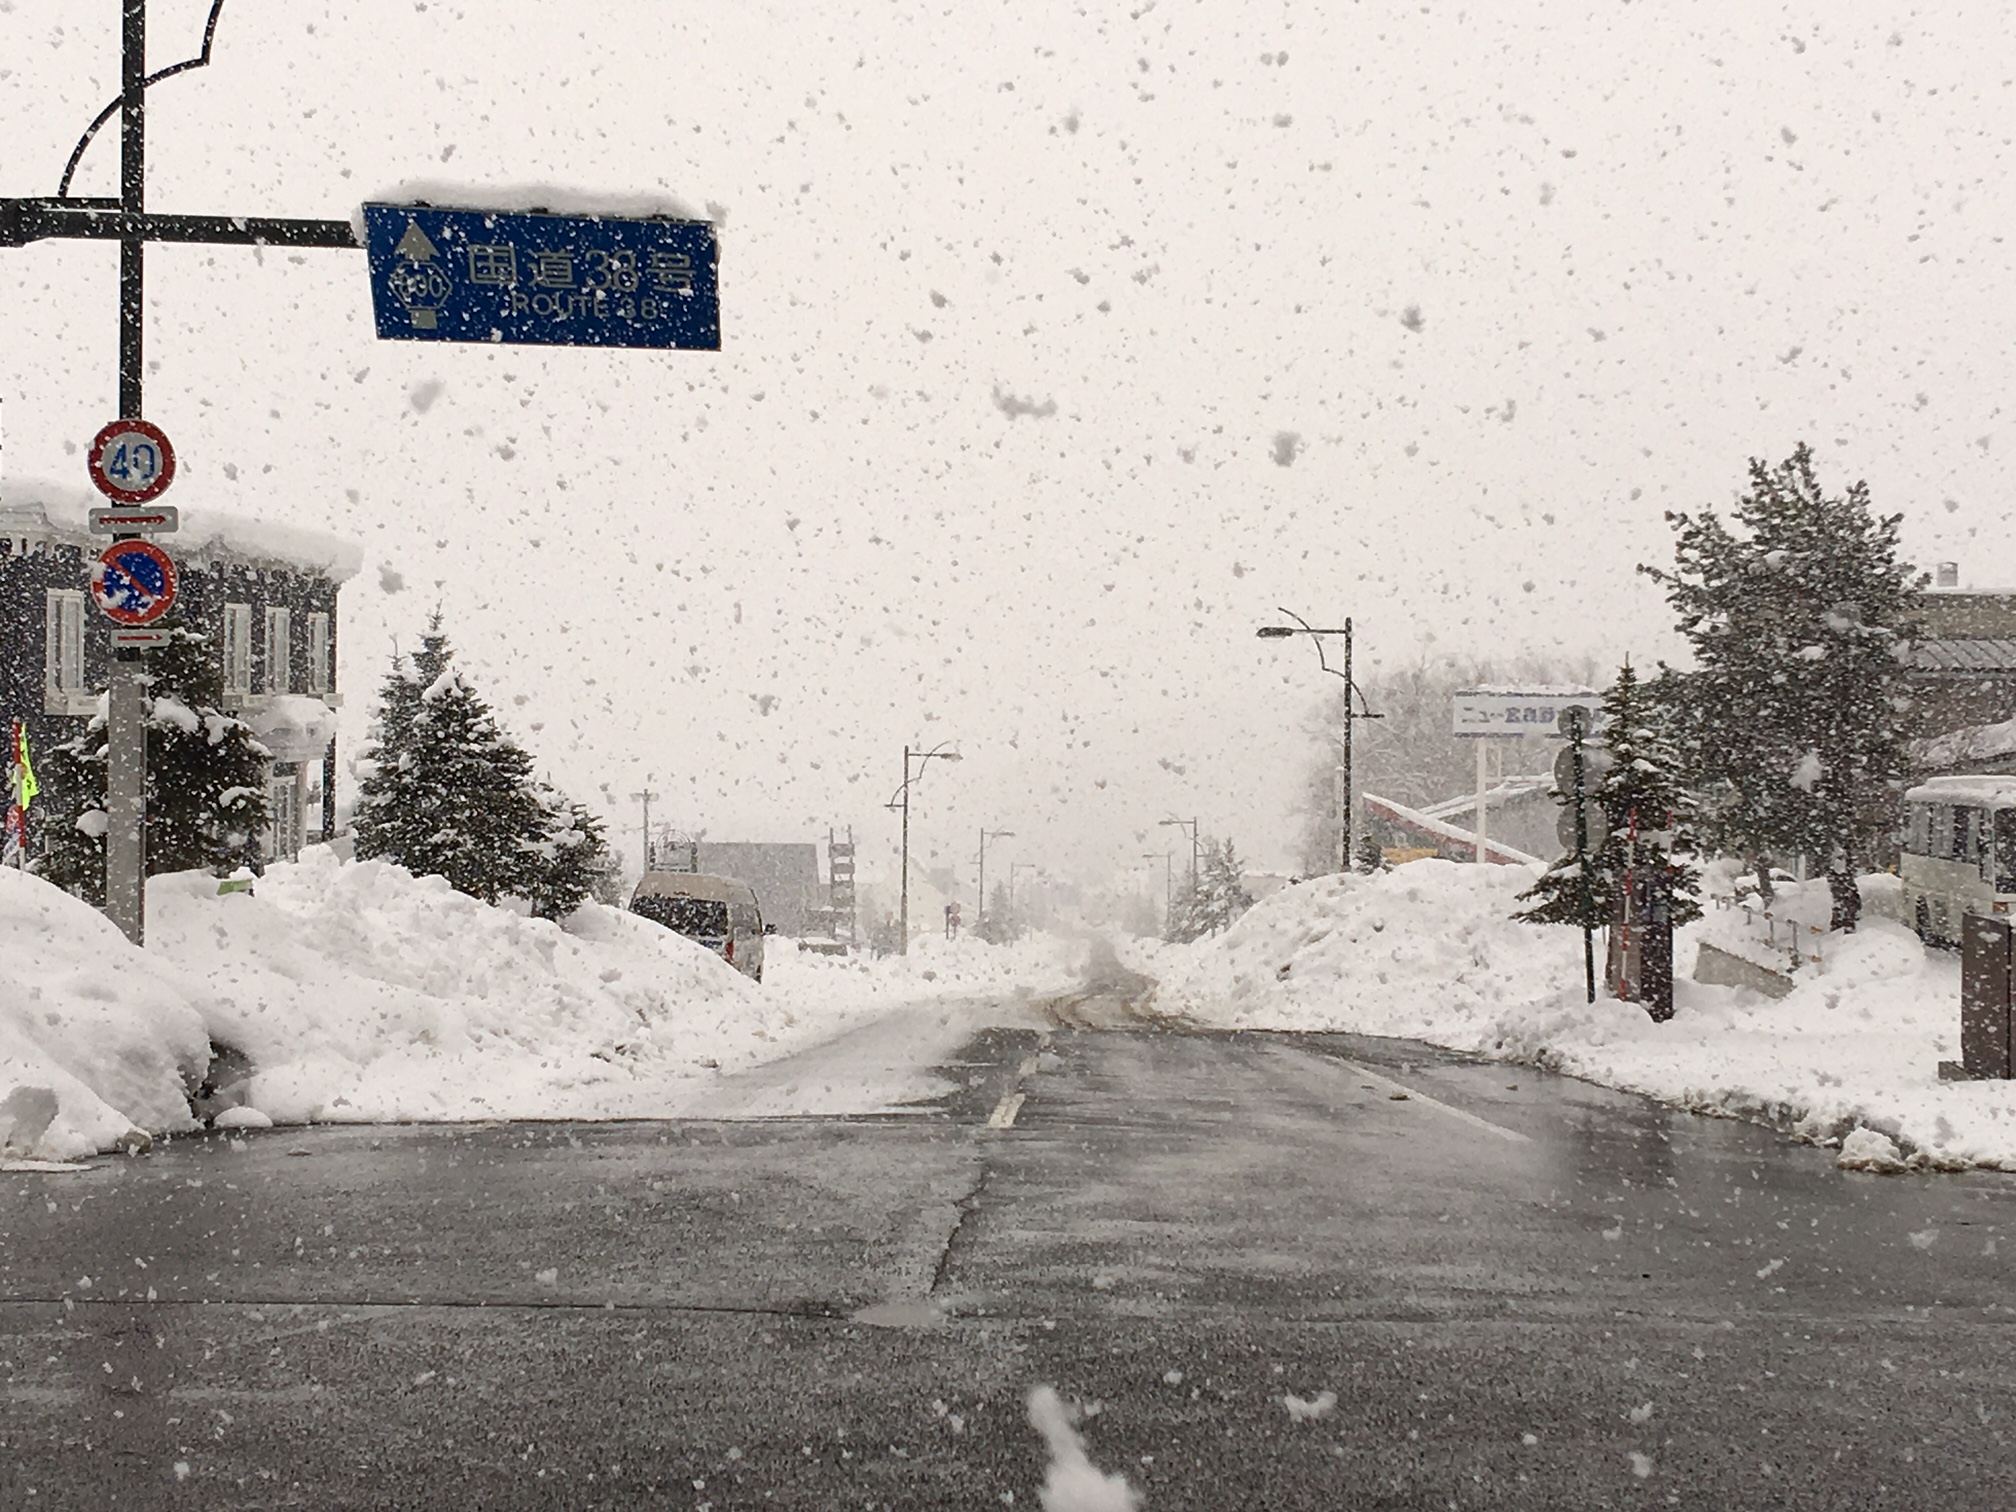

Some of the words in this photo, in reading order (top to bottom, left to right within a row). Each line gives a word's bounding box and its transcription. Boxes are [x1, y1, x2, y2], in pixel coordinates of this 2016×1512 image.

[468, 244, 697, 293] 国道38号
[512, 292, 609, 319] ROUTE
[621, 295, 658, 320] 38
[110, 443, 155, 480] 40
